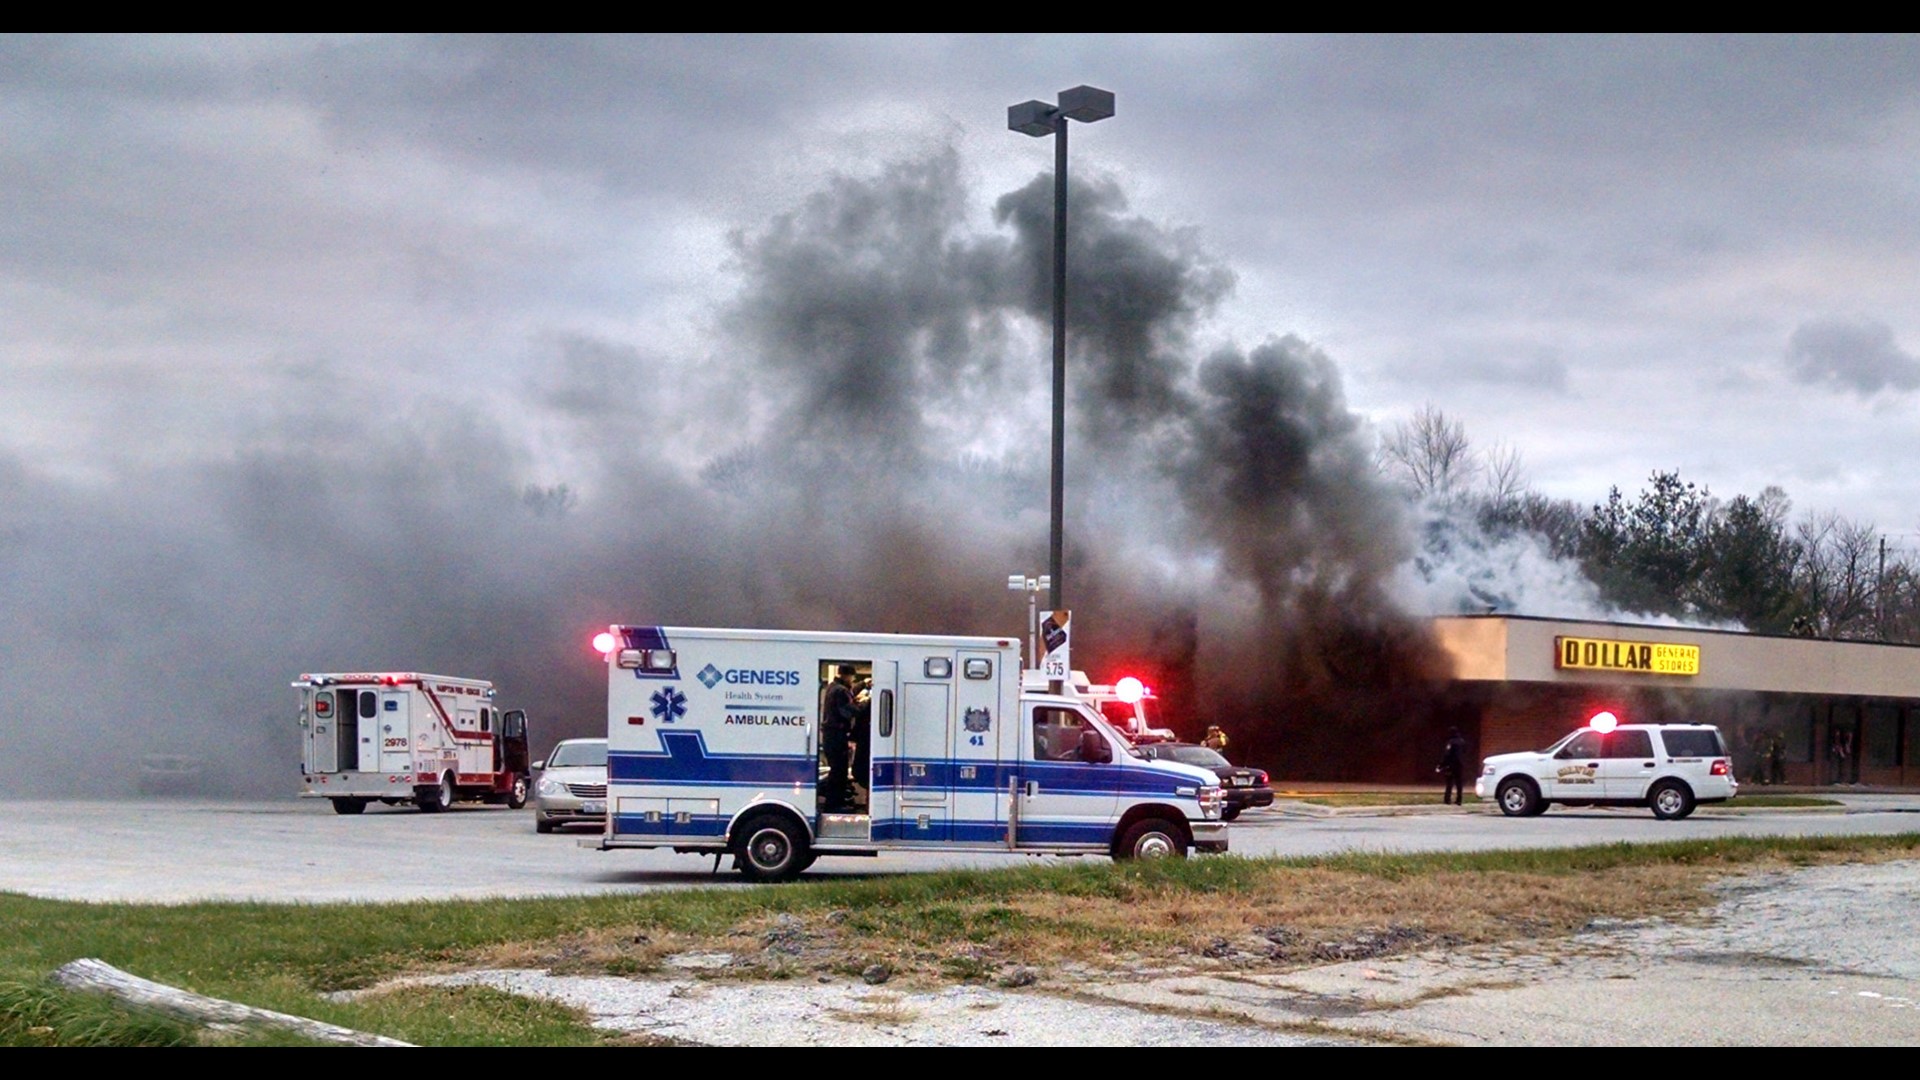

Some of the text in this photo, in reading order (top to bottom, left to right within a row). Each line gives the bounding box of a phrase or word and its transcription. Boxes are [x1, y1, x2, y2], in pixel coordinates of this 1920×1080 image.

[1565, 640, 1652, 669] DOLLAR
[1046, 662, 1064, 676] 5.75
[1659, 659, 1694, 672] STORES
[724, 669, 800, 686] GENESIS
[725, 691, 783, 701] Health System
[724, 714, 806, 727] AMBULANCE
[384, 737, 408, 747] 2978
[969, 735, 984, 746] 41
